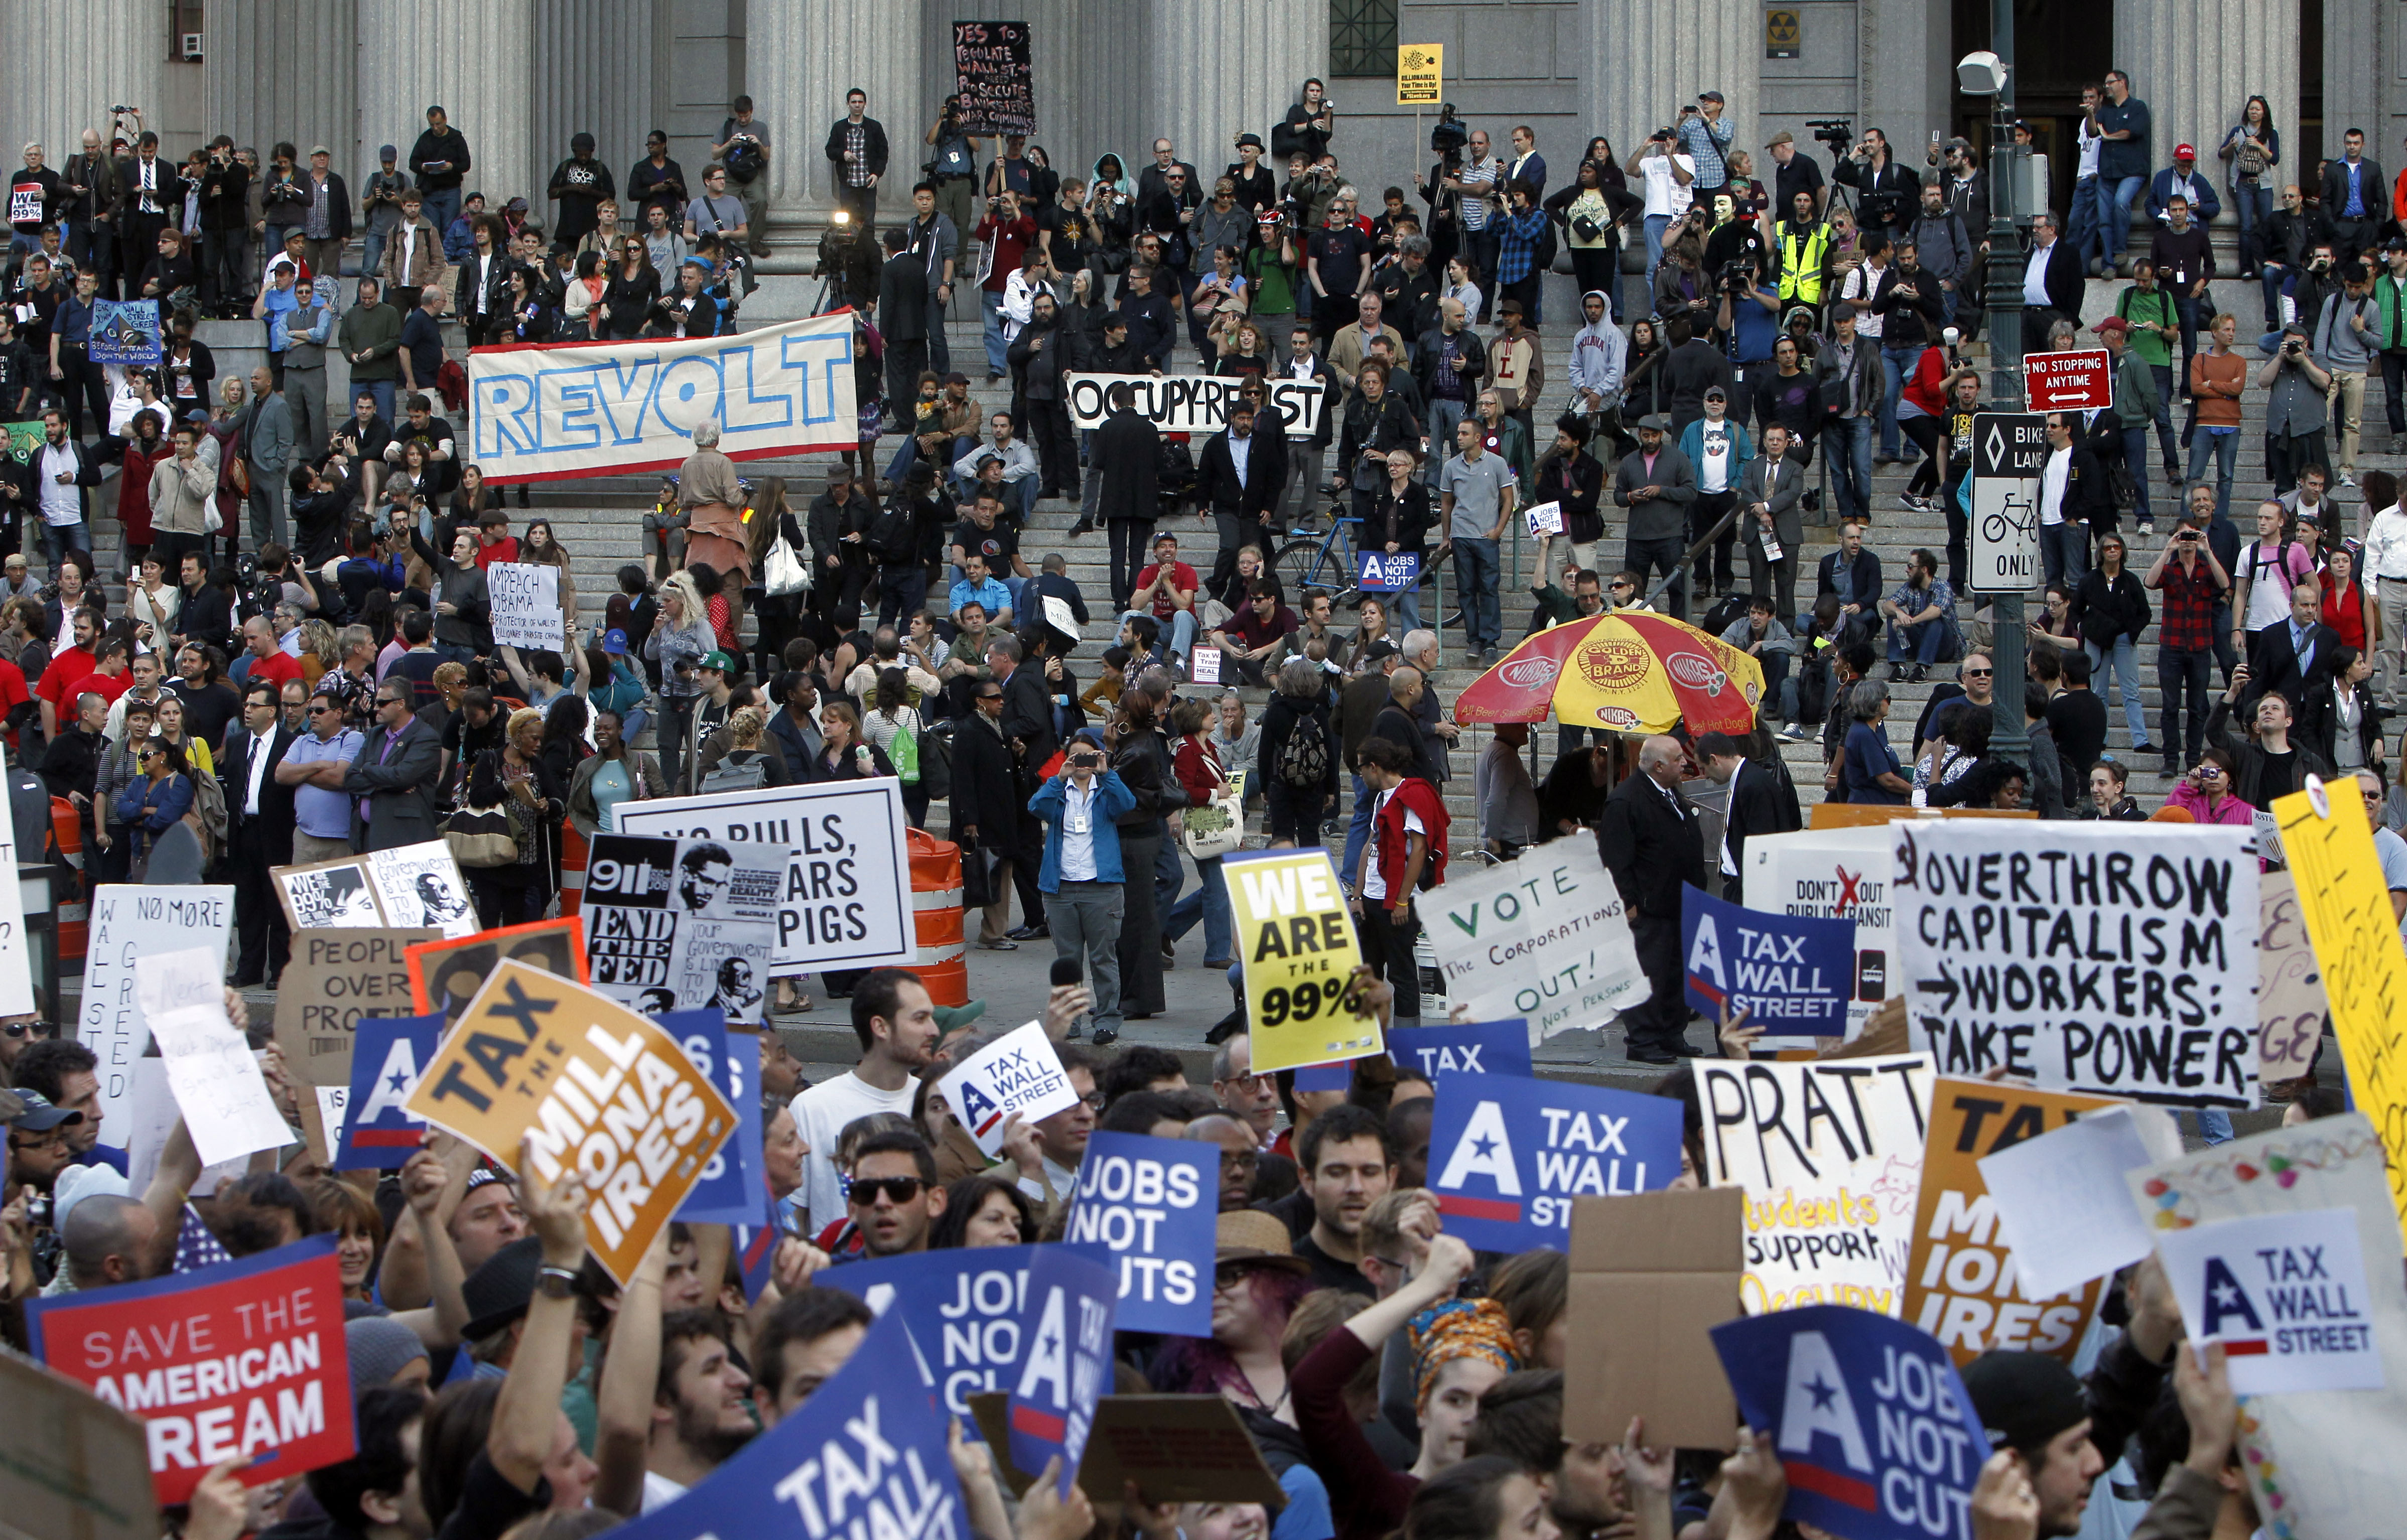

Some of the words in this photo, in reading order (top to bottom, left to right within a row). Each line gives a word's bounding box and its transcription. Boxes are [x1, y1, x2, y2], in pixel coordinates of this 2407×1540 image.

[956, 24, 988, 45] YES
[568, 172, 597, 180] MOON
[13, 209, 41, 218] 99%
[95, 303, 108, 312] TEAR
[125, 305, 145, 314] WALL
[131, 320, 158, 328] GREED
[91, 341, 118, 351] BEFORE
[118, 344, 125, 352] IT
[2032, 361, 2047, 373] NO
[2051, 358, 2101, 372] STOPPING
[2046, 374, 2091, 388] ANYTIME
[474, 332, 852, 459] REVOLT
[2016, 427, 2043, 444] BIKE
[2014, 451, 2042, 468] LANE
[1539, 506, 1558, 517] JOBS
[1539, 514, 1554, 522] NOT
[1541, 520, 1560, 530] CUTS
[1385, 556, 1414, 566] JOBS
[1385, 566, 1406, 576] NOT
[1996, 554, 2035, 576] ONLY
[493, 594, 533, 612] OBAMA
[495, 614, 526, 626] PROTECTOR
[1588, 644, 1644, 656] GOLDEN
[1508, 661, 1556, 683] NIKAS
[1593, 663, 1642, 677] BRAND
[1674, 659, 1711, 683] NIKAS
[1580, 675, 1609, 695] Brooklyn,
[1627, 679, 1648, 694] 11211
[1502, 706, 1545, 718] Sausages
[1600, 708, 1632, 723] NIKAS
[1689, 720, 1705, 732] Beef
[1708, 720, 1724, 731] Hot
[1726, 719, 1749, 732] Dogs
[2255, 813, 2275, 823] JUSTIC
[291, 874, 318, 893] WE
[590, 858, 652, 895] 911
[1926, 852, 2232, 918] OVERTHROW
[293, 891, 332, 913] 99%
[389, 897, 409, 912] TO
[1241, 864, 1335, 920] WE
[1448, 866, 1579, 938] VOTE
[1797, 880, 1838, 901] DON'T
[1860, 883, 1884, 903] OUT
[595, 907, 676, 940] END
[779, 902, 867, 947] PIGS
[593, 938, 671, 957] THE
[1254, 912, 1349, 963] ARE
[1737, 927, 1807, 964] TAX
[1919, 904, 2227, 972] CAPITALISM
[589, 955, 668, 987] FED
[684, 973, 704, 987] TO
[1289, 958, 1329, 977] THE
[1442, 958, 1474, 981] The
[1514, 949, 1596, 1013] OUT!
[1734, 959, 1832, 995] WALL
[325, 973, 411, 998] OVER
[1962, 962, 2222, 1026] WORKERS:
[1261, 975, 1364, 1028] 99%
[1542, 1006, 1570, 1030] NOT
[1582, 979, 1631, 1008] PERSONS
[1732, 993, 1839, 1018] STREET
[431, 975, 559, 1115] TAX
[1919, 1015, 2037, 1078] TAKE
[2061, 1020, 2248, 1095] POWER
[516, 1040, 565, 1099] THE
[984, 1047, 1030, 1080] TAX
[1416, 1043, 1486, 1076] TAX
[993, 1060, 1054, 1098] WALL
[330, 1090, 345, 1108] IS
[522, 1024, 645, 1182] MILL
[1005, 1074, 1065, 1112] STREET
[1540, 1107, 1630, 1156] TAX
[1705, 1060, 1924, 1188] PRATT
[590, 1081, 705, 1252] IRES
[1081, 1154, 1199, 1208] JOBS
[1071, 1203, 1166, 1252] NOT
[2256, 1244, 2329, 1282] TAX
[2265, 1284, 2361, 1321] WALL
[83, 1313, 216, 1369] SAVE
[234, 1287, 317, 1340] THE
[1916, 1291, 2081, 1353] IRES
[2276, 1324, 2370, 1354] STREET
[94, 1331, 322, 1412] AMERICAN
[145, 1379, 326, 1472] REAM
[1876, 1403, 1971, 1484] NOT
[774, 1394, 900, 1539] TAX
